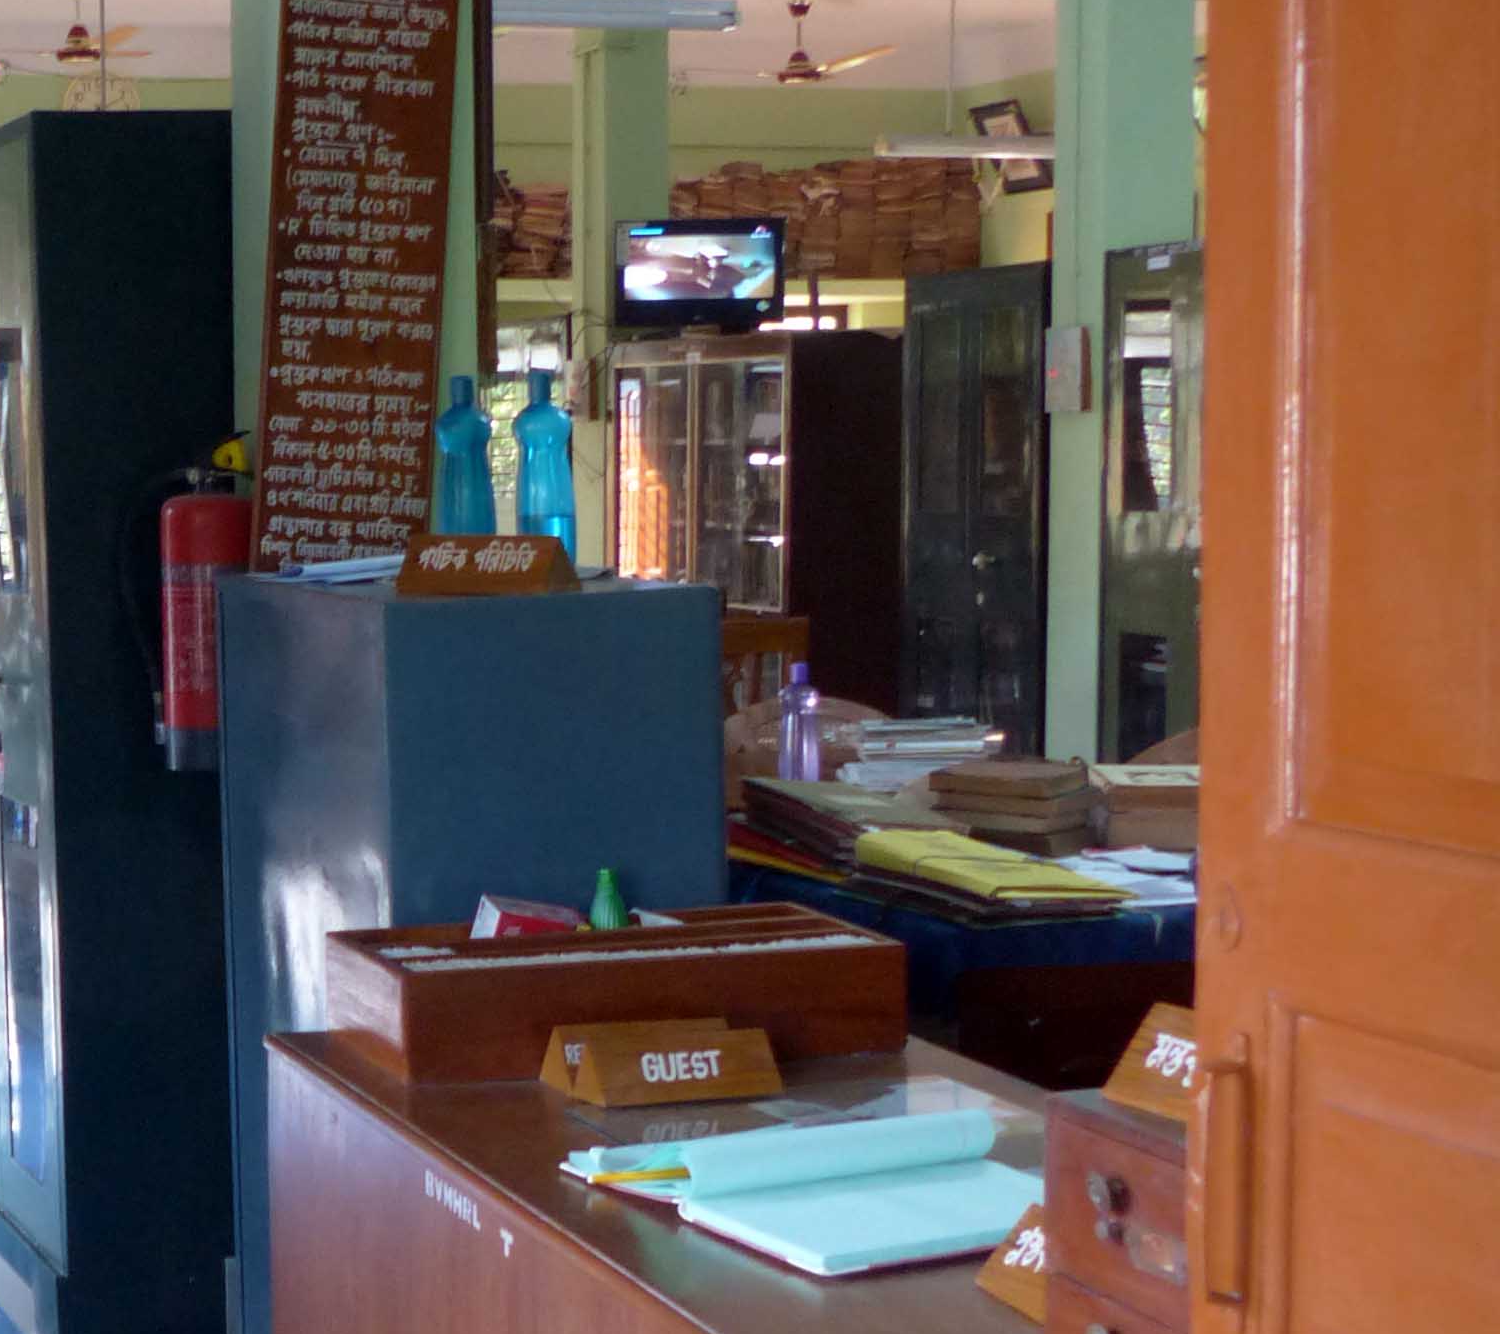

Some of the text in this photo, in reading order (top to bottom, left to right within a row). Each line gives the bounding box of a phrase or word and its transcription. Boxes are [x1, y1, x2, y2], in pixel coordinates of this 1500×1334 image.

[279, 364, 318, 387] পুস্তক
[269, 416, 301, 432] বেলা
[641, 1050, 721, 1082] GUEST
